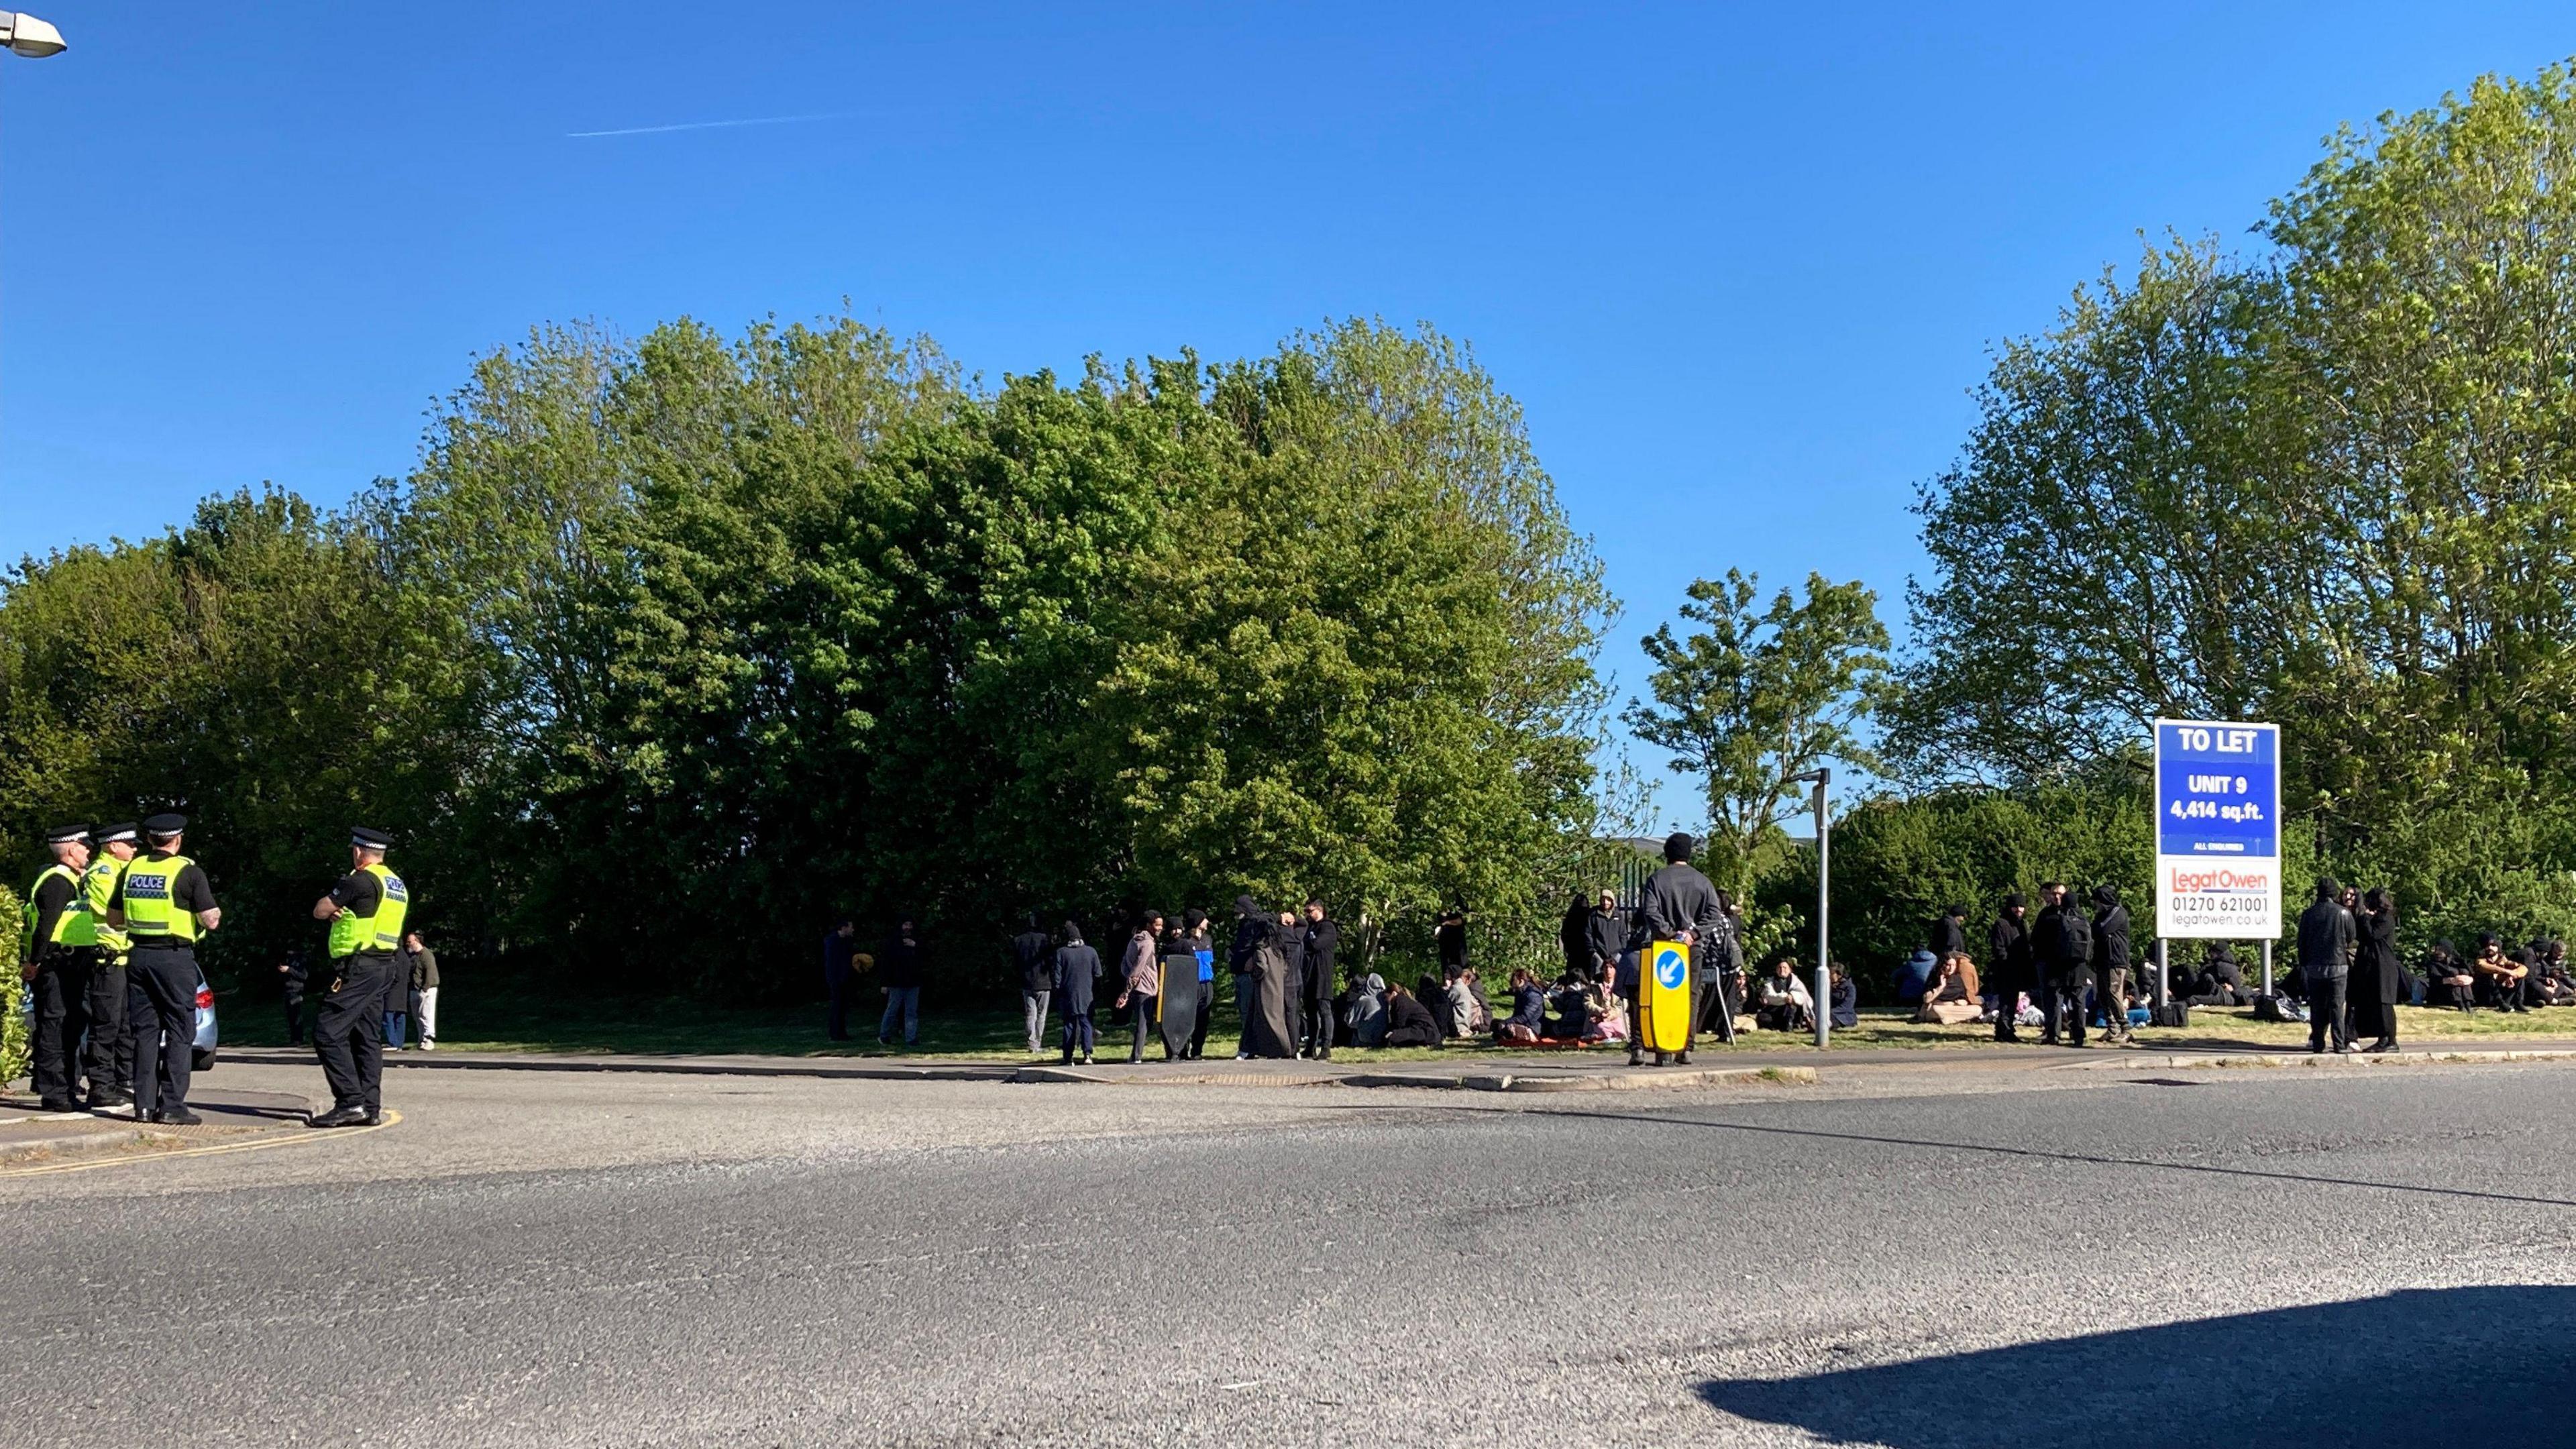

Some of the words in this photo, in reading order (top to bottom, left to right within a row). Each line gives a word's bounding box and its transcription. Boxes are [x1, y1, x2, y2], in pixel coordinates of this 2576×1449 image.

[2178, 728, 2210, 751] TO
[2216, 729, 2258, 753] LET
[2188, 774, 2232, 794] UNIT
[2235, 776, 2247, 794] 9
[2170, 800, 2217, 820] 4,414
[2220, 802, 2264, 823] sq.ft.
[2194, 842, 2207, 851] ALL
[2208, 842, 2245, 851] ENQUS
[129, 875, 164, 888] POLICE
[2173, 897, 2214, 911] 01270
[2220, 897, 2267, 912] 621001
[2173, 913, 2268, 928] legatowen.co.uk
